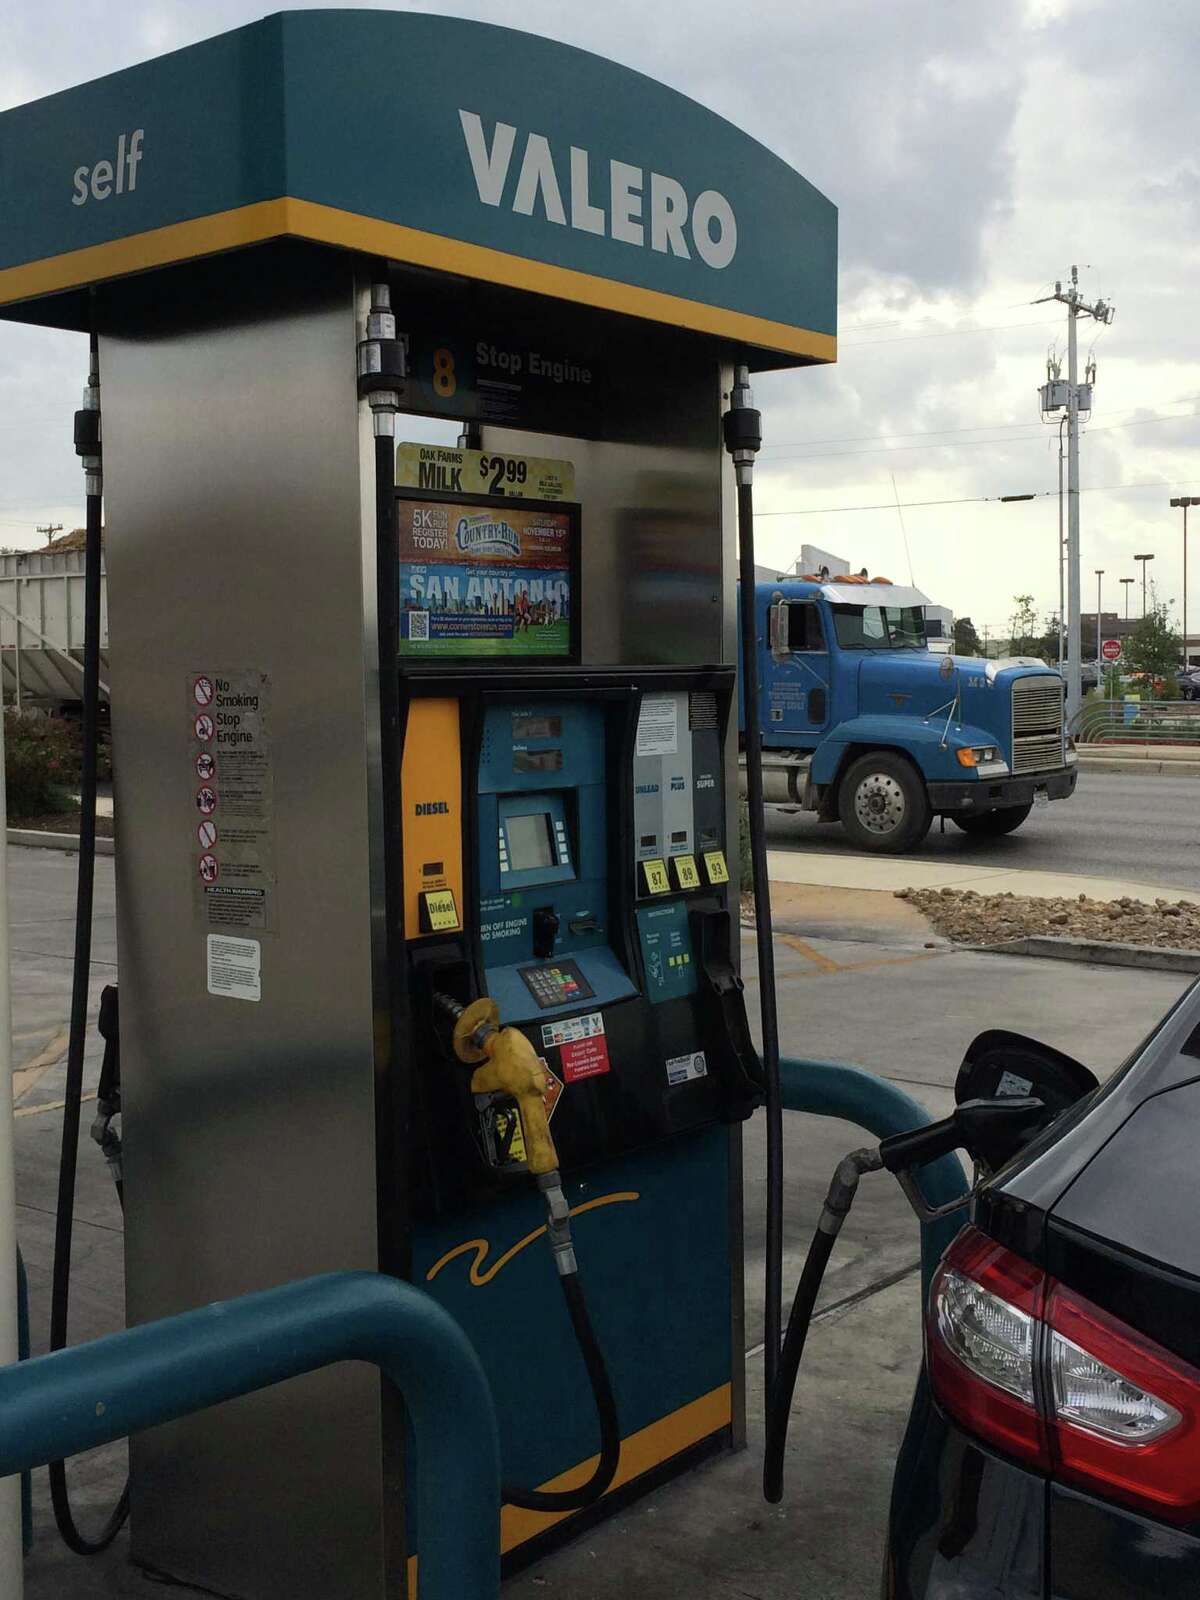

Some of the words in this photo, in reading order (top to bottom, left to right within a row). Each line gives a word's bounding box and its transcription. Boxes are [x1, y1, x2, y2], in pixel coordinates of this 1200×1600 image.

[71, 128, 145, 206] self
[458, 108, 738, 270] VALERO
[476, 342, 522, 374] Stop
[528, 351, 593, 384] Engine
[432, 348, 457, 397] 8
[419, 448, 436, 461] OAK
[437, 449, 463, 464] FARMS
[418, 462, 463, 491] MILK
[413, 509, 432, 528] 5K
[412, 527, 448, 537] REGISTER
[412, 536, 448, 549] TODAY!
[410, 574, 459, 600] SAN
[215, 679, 230, 692] No
[215, 693, 259, 711] Smoking
[216, 713, 241, 729] Stop
[216, 730, 253, 746] Engine
[415, 801, 450, 816] DIESEL
[651, 871, 663, 886] 87
[711, 862, 723, 876] 93
